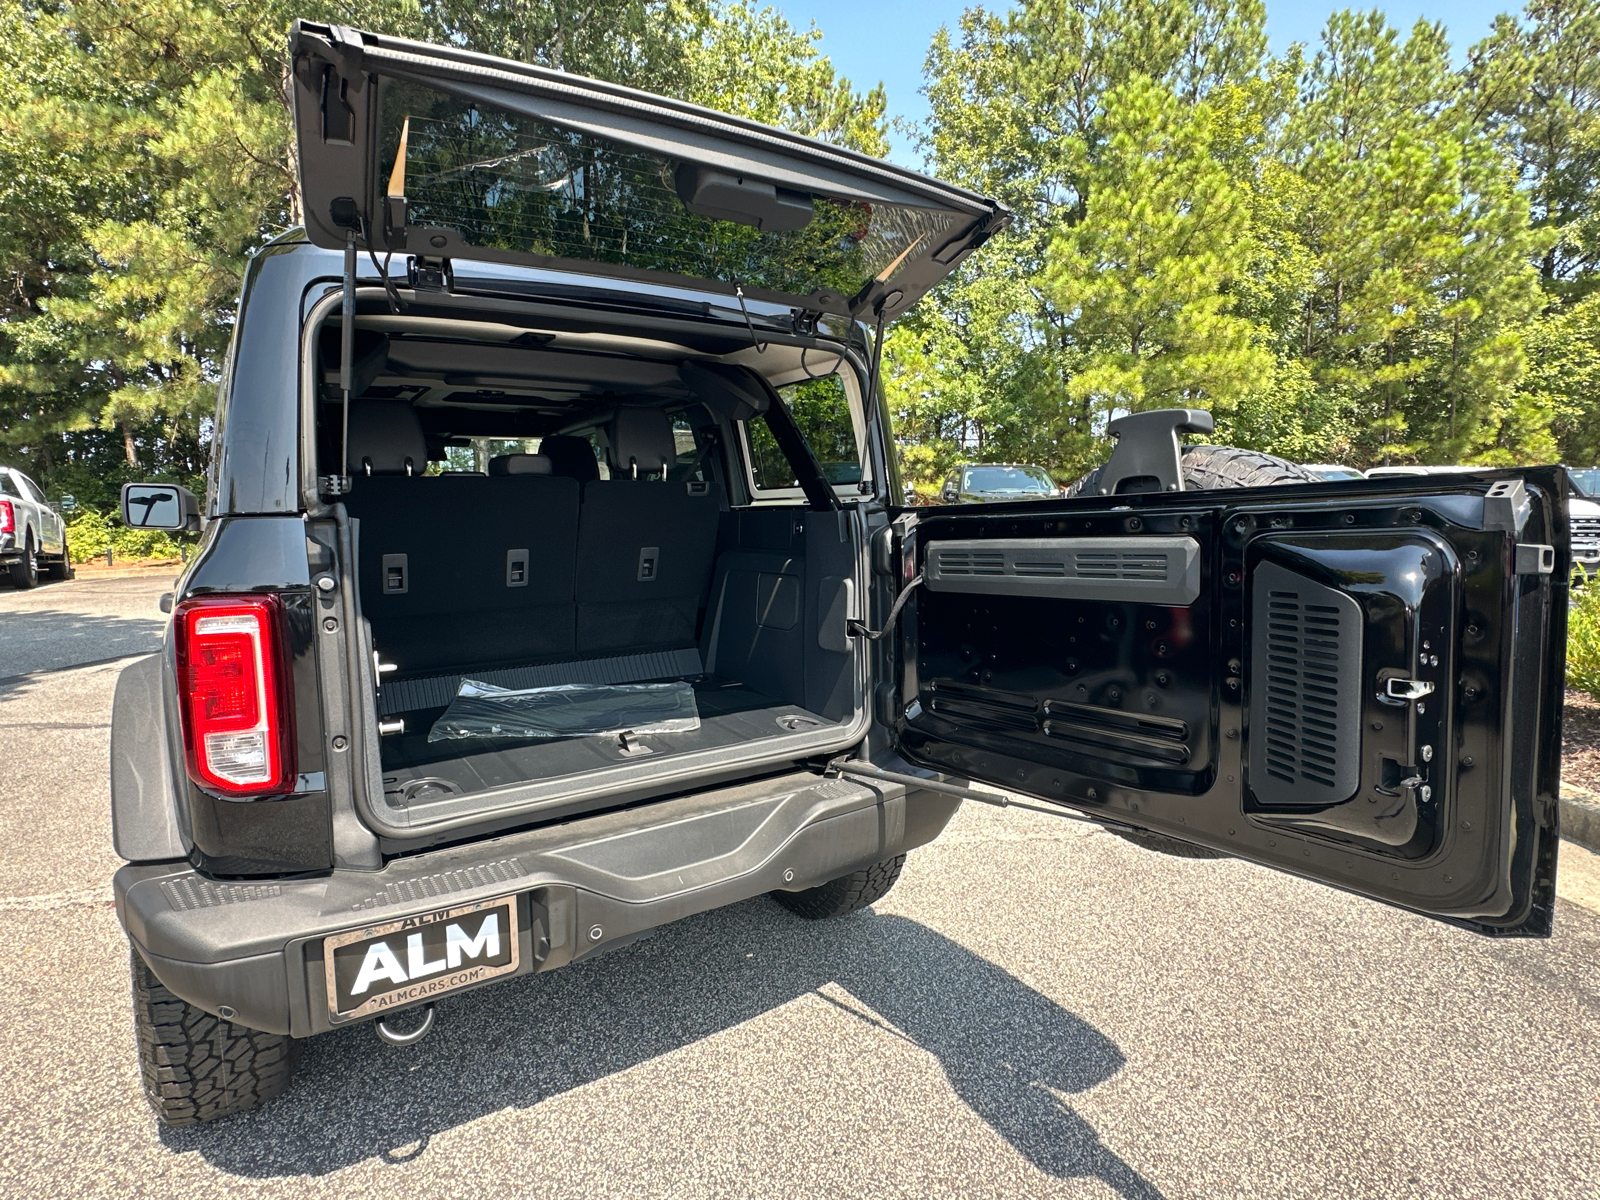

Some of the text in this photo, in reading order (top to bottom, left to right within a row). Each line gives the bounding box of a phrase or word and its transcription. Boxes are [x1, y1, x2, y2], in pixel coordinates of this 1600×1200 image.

[401, 910, 450, 929] ALM
[351, 913, 500, 995] ALM
[378, 970, 479, 1007] ALMCARS.COM
